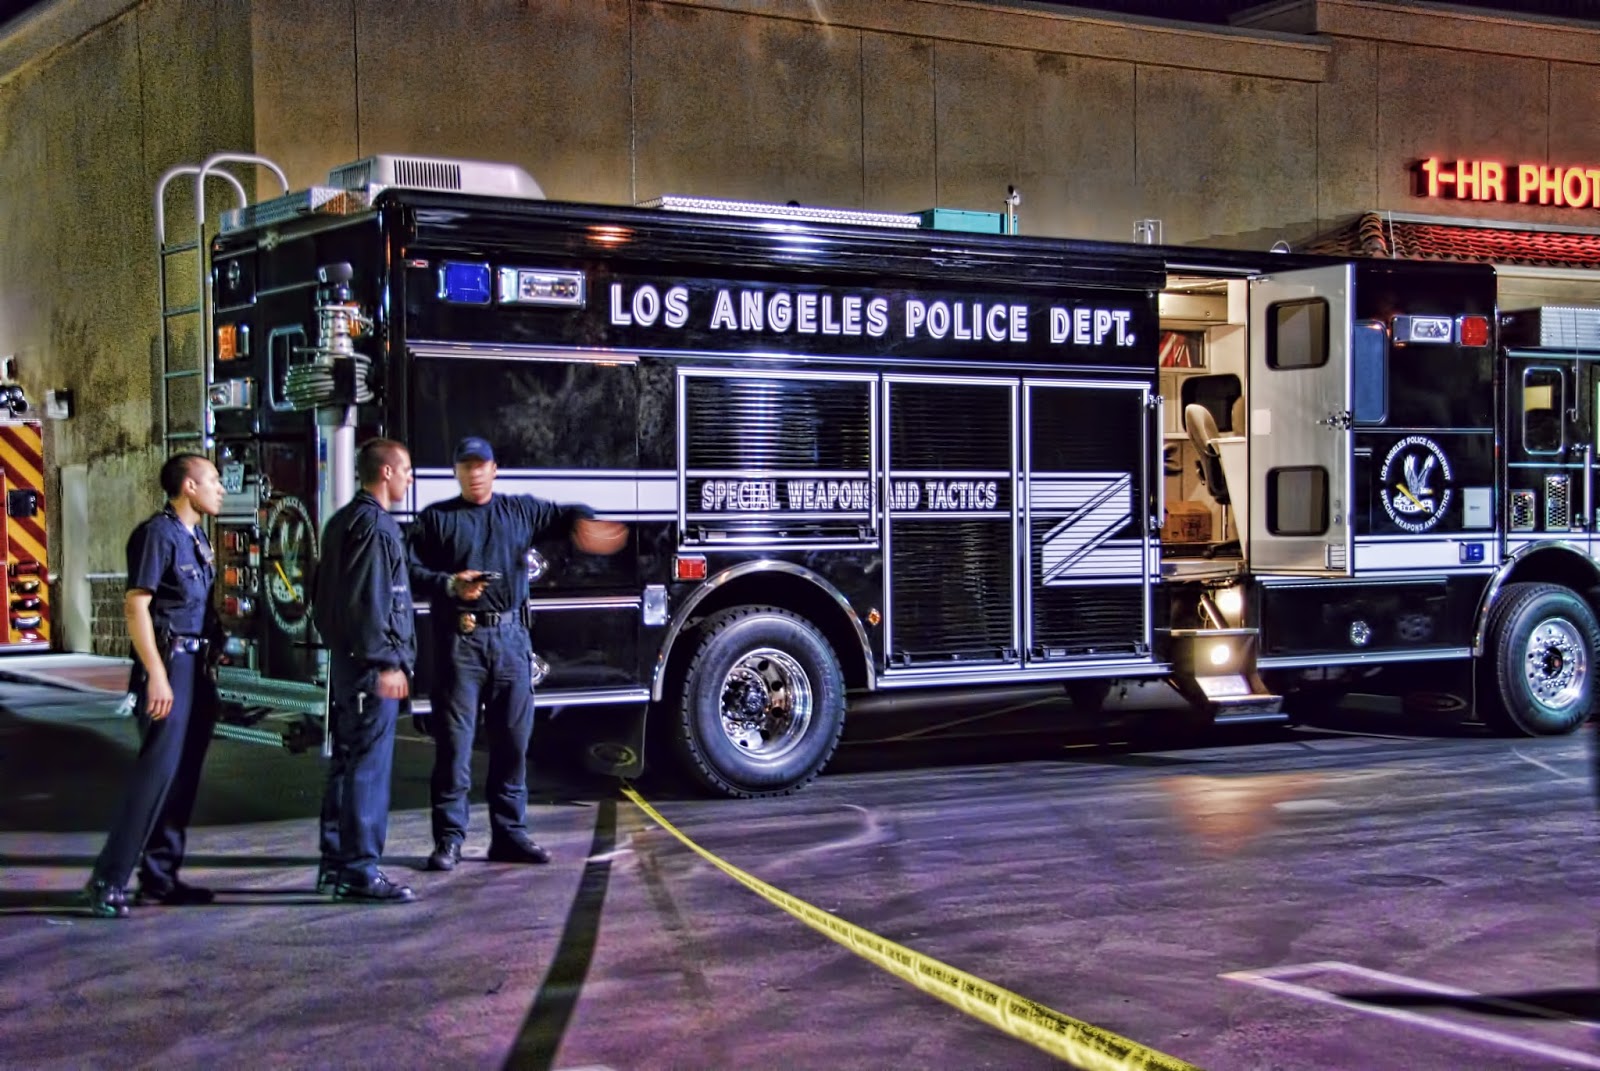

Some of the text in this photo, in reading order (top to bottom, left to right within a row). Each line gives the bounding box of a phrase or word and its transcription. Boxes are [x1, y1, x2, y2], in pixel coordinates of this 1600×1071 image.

[1422, 157, 1504, 201] 1-HR
[611, 283, 1135, 347] LOS ANGELES POLICE DEPT.
[1380, 436, 1451, 480] LOS ANGELES POLICE DEPARTMENT
[701, 480, 997, 510] SPECIAL WEAPONS AND TACTICS
[1380, 489, 1451, 531] SPECIAL WEAPONS AND TACTICS
